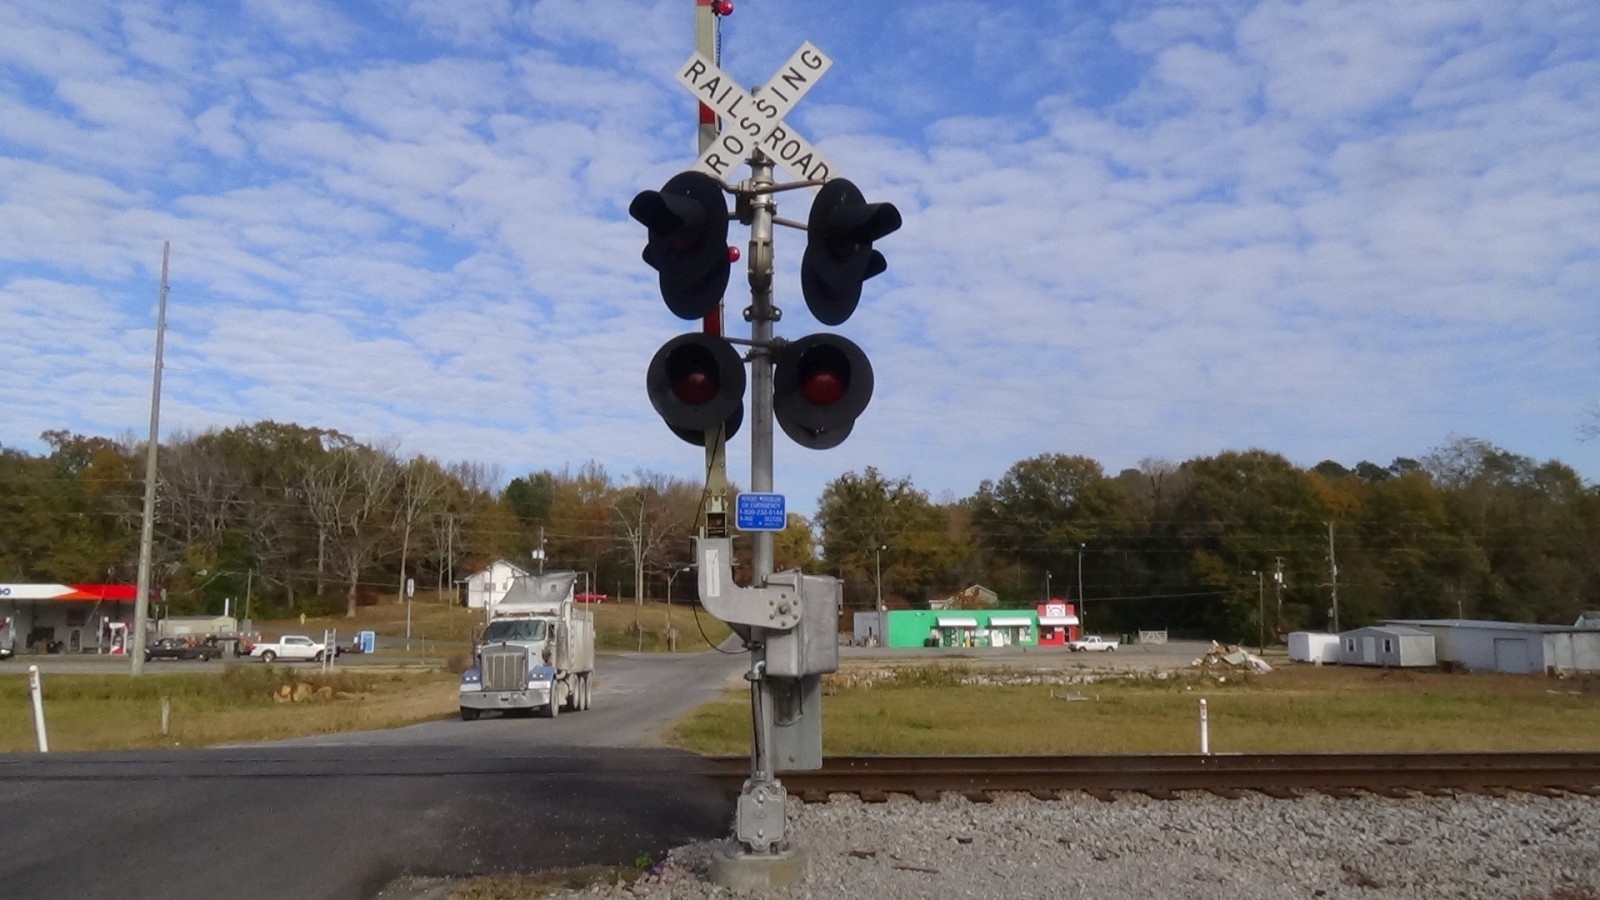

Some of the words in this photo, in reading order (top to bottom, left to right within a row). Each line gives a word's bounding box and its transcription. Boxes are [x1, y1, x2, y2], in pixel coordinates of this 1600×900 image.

[684, 59, 743, 119] RAIL
[704, 50, 823, 175] ROSSING
[764, 126, 829, 182] ROAD
